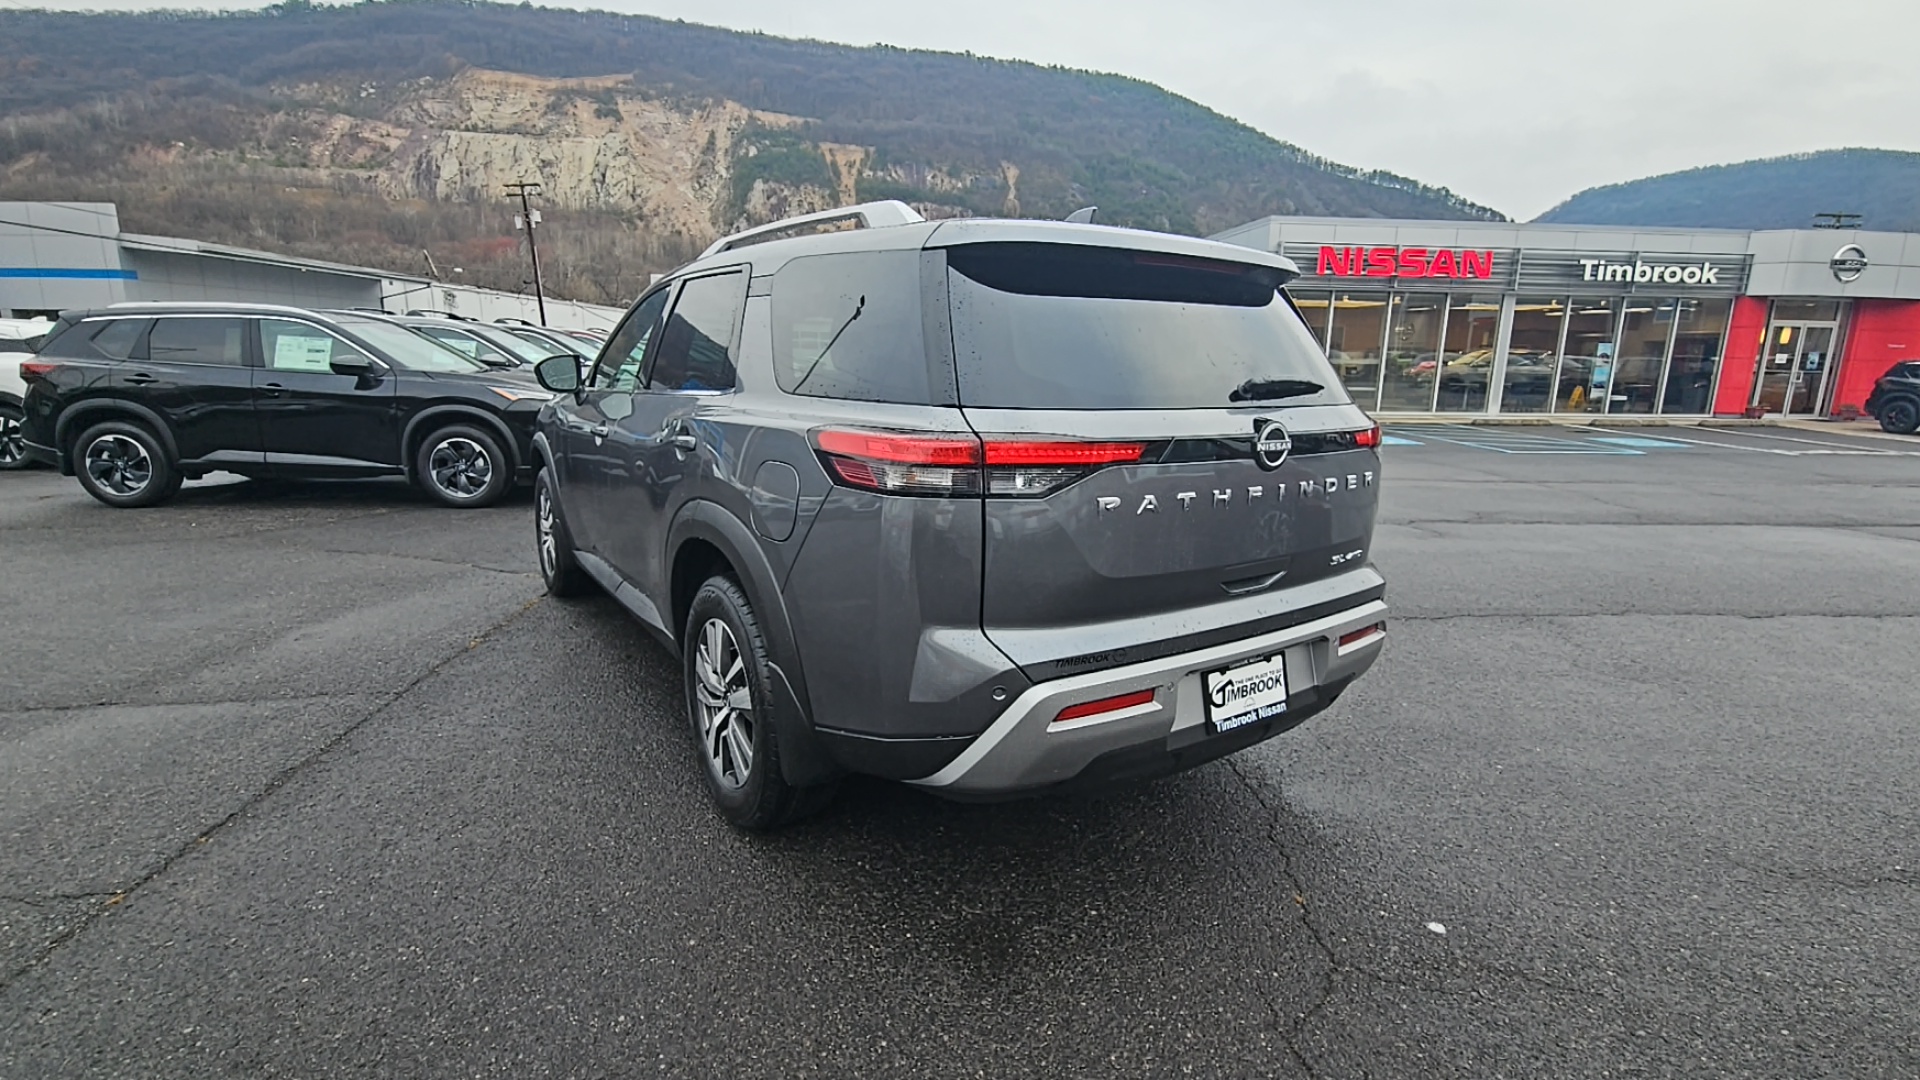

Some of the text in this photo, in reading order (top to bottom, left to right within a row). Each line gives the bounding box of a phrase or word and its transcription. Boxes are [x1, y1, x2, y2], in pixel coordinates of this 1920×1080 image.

[1316, 246, 1494, 279] NISSAN
[1579, 259, 1719, 284] Timbrook
[1257, 440, 1292, 451] NISSAN
[1096, 471, 1374, 515] PATHFINDER
[1055, 653, 1111, 668] TIMBROOK
[1215, 702, 1287, 732] Timbrook Nissan
